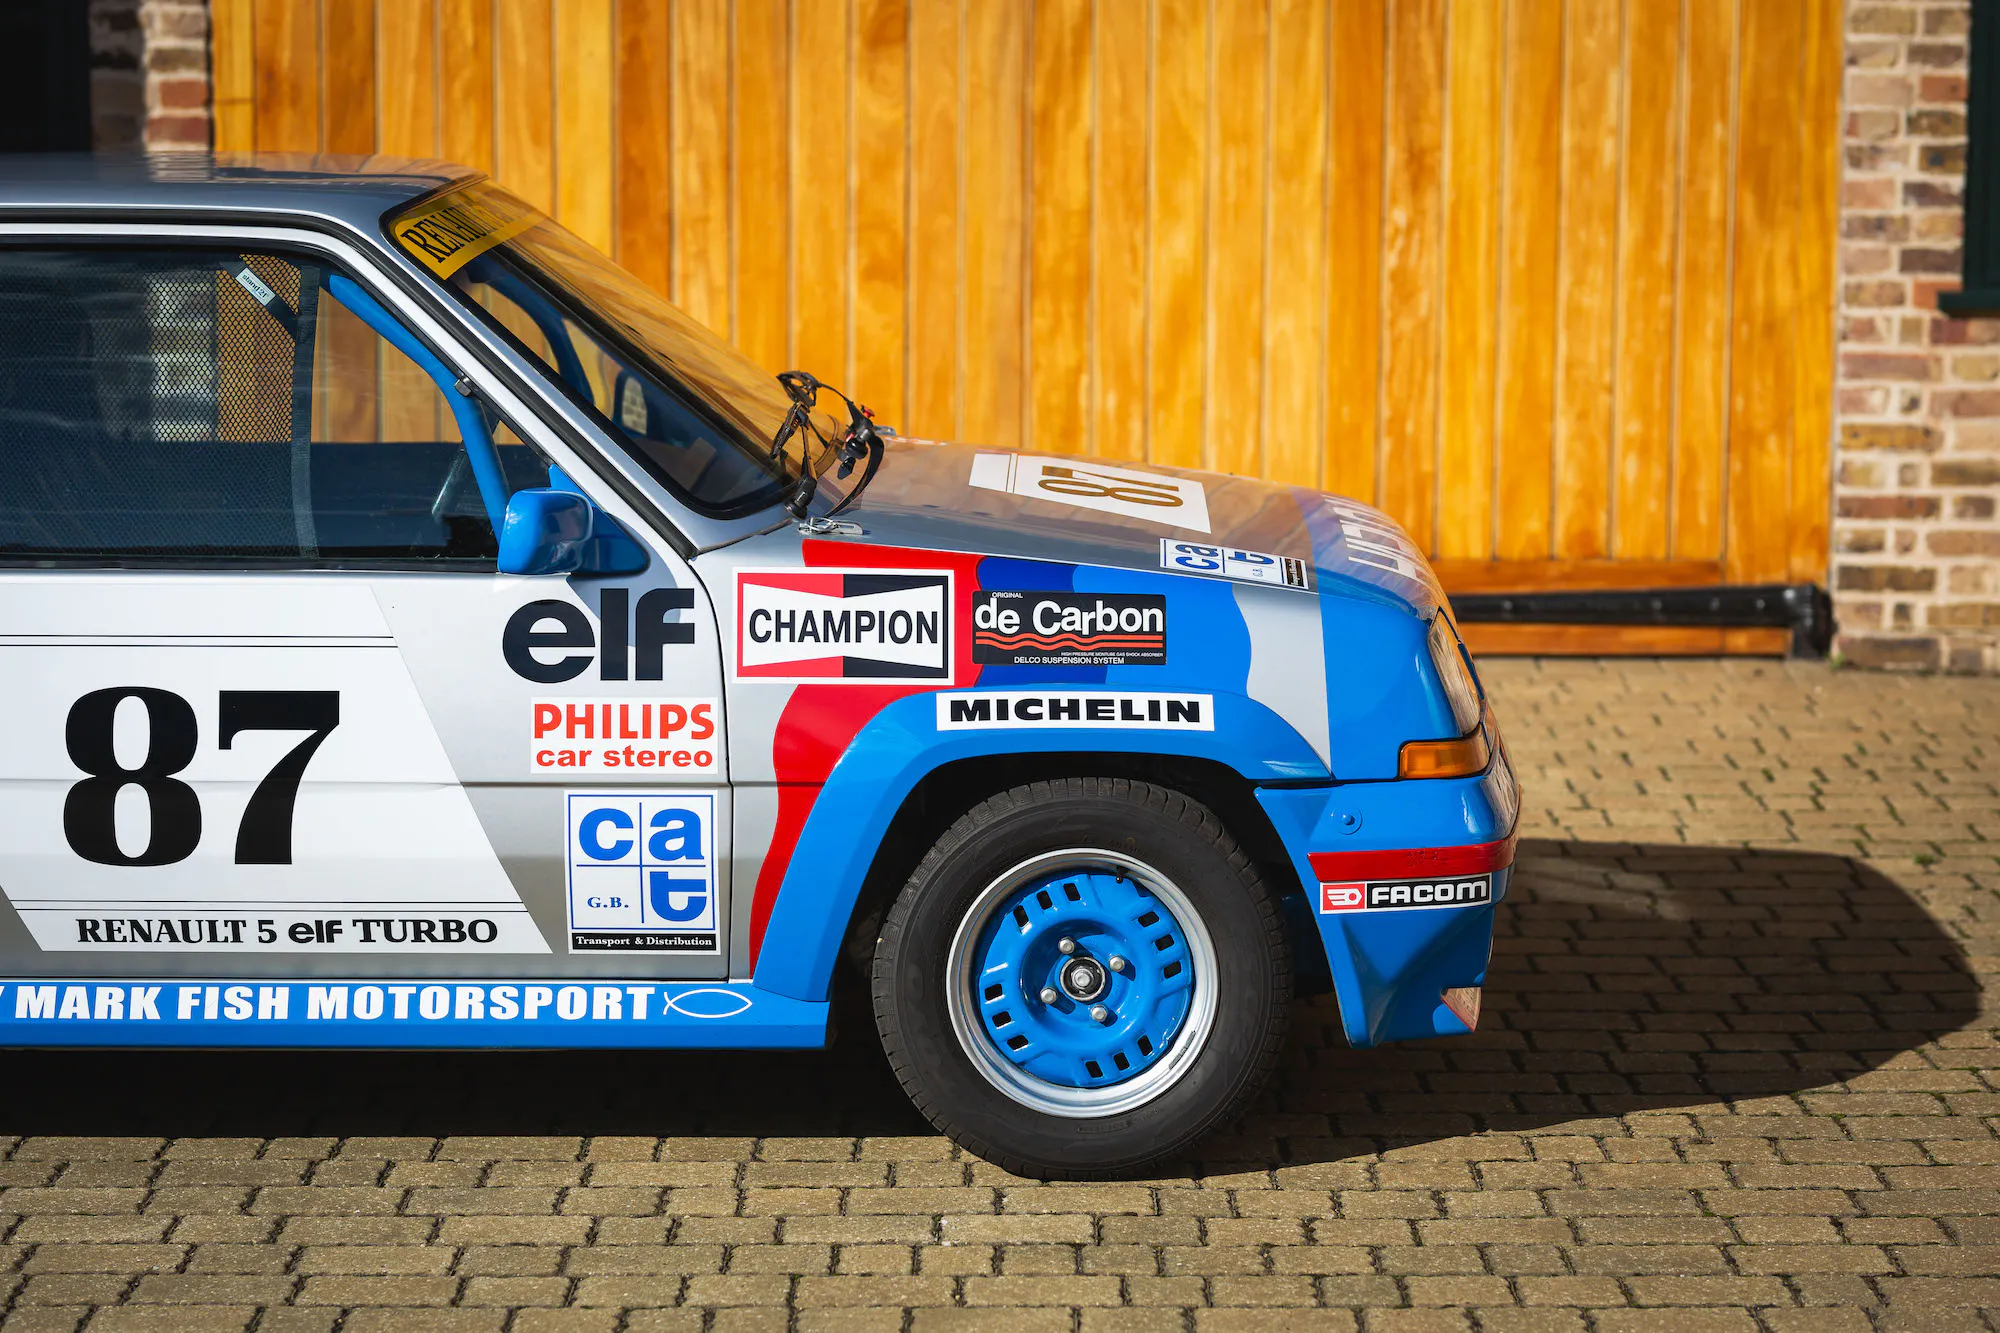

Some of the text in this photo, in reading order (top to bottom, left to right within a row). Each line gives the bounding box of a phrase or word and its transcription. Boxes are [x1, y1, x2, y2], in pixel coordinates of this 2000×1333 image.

[991, 591, 1024, 599] ORIGINAL
[749, 608, 938, 645] CHAMPION
[974, 597, 1164, 636] de Carbon
[502, 588, 695, 684] elf
[1014, 656, 1125, 665] DELCO SUSPENSION SYSTEM
[534, 703, 715, 740] PHILIPS
[950, 698, 1201, 724] MICHELIN
[536, 744, 713, 768] car stereo
[62, 685, 340, 867] 87
[587, 897, 630, 909] G.B.
[77, 918, 498, 945] RENAULT 5 elf TURBO
[575, 936, 713, 947] Transport & Distribution
[15, 985, 162, 1020] MARK
[176, 985, 290, 1020] FISH
[307, 984, 657, 1022] MOTORSPORT
